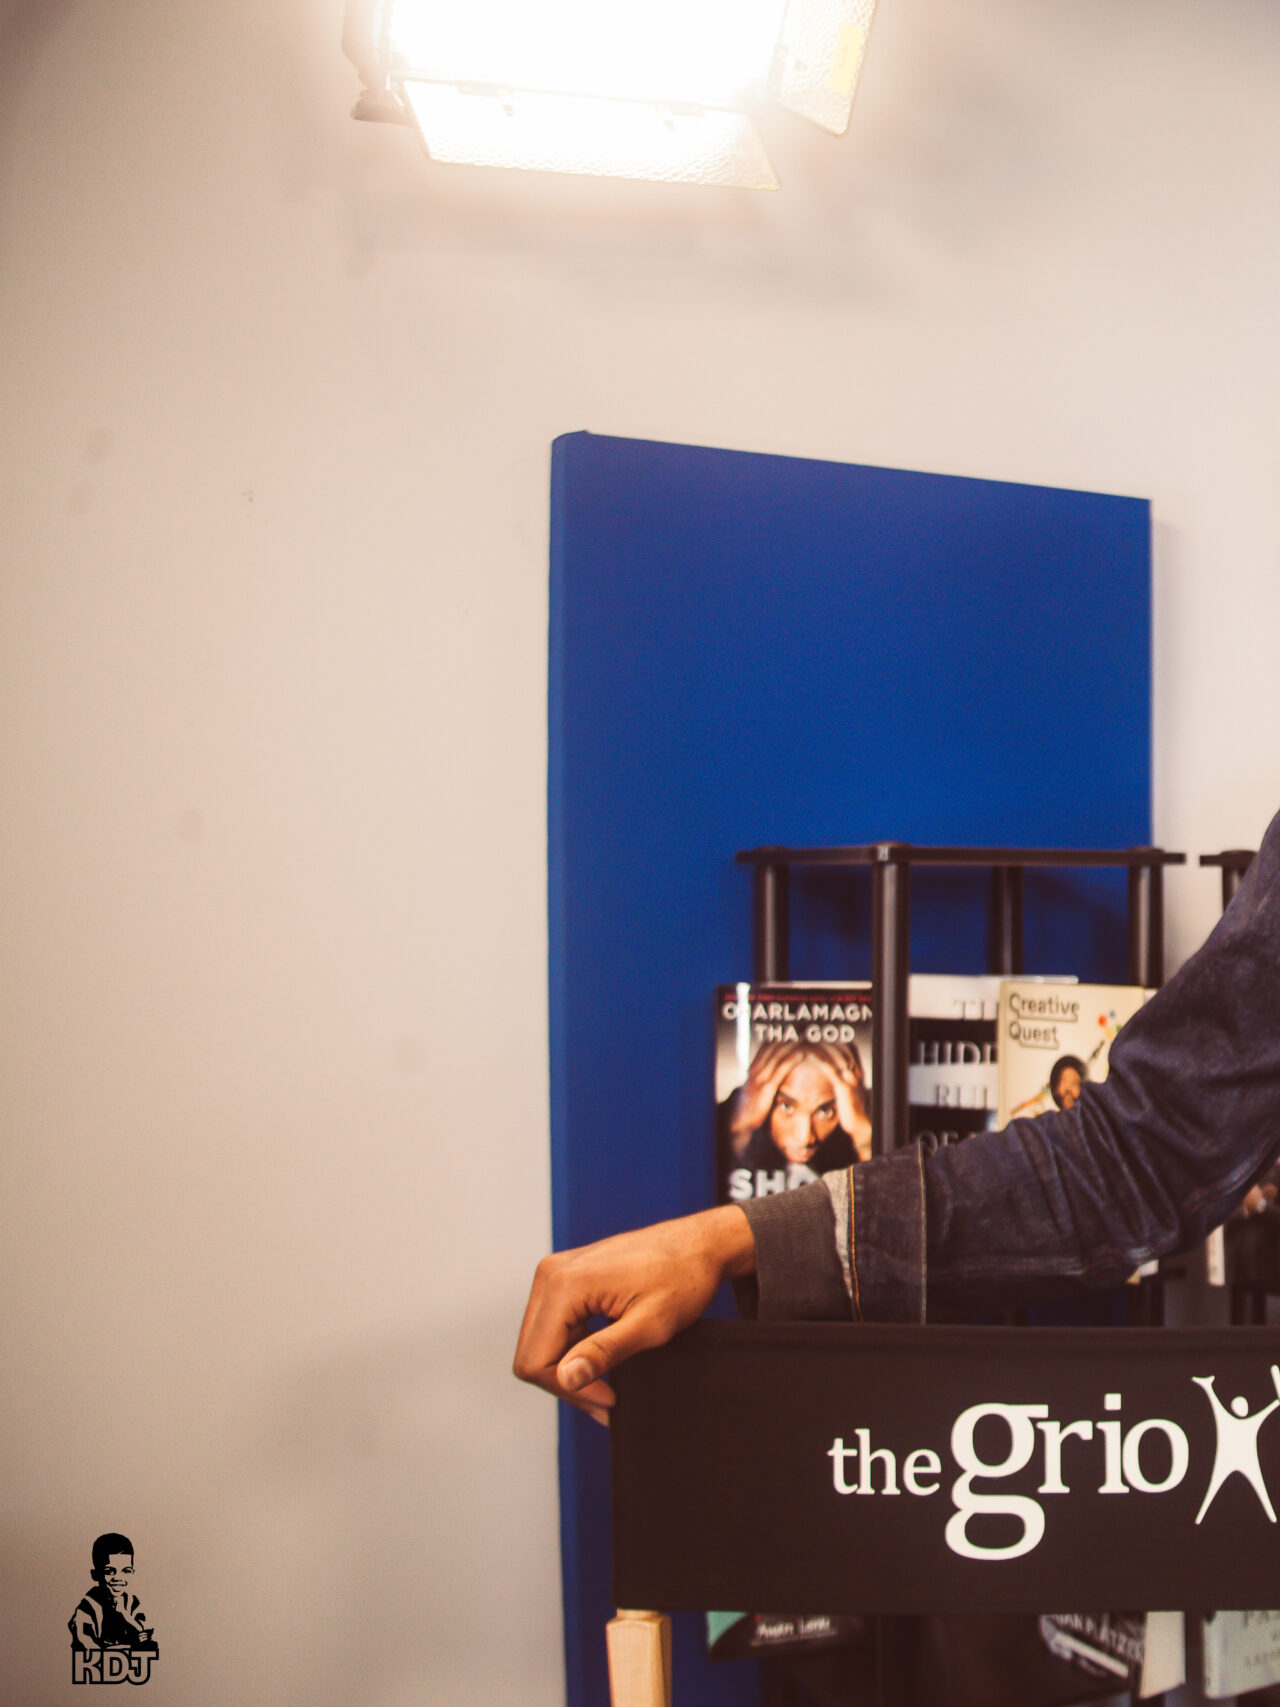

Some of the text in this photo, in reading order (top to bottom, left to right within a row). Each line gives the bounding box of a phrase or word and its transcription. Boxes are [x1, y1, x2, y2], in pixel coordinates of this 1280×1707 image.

[722, 1001, 873, 1022] CARLAMAGN
[953, 999, 999, 1020] TH
[1009, 993, 1079, 1018] Creative
[755, 1023, 855, 1044] THA GOD
[1009, 1021, 1059, 1043] Quest
[729, 1168, 819, 1200] SHO
